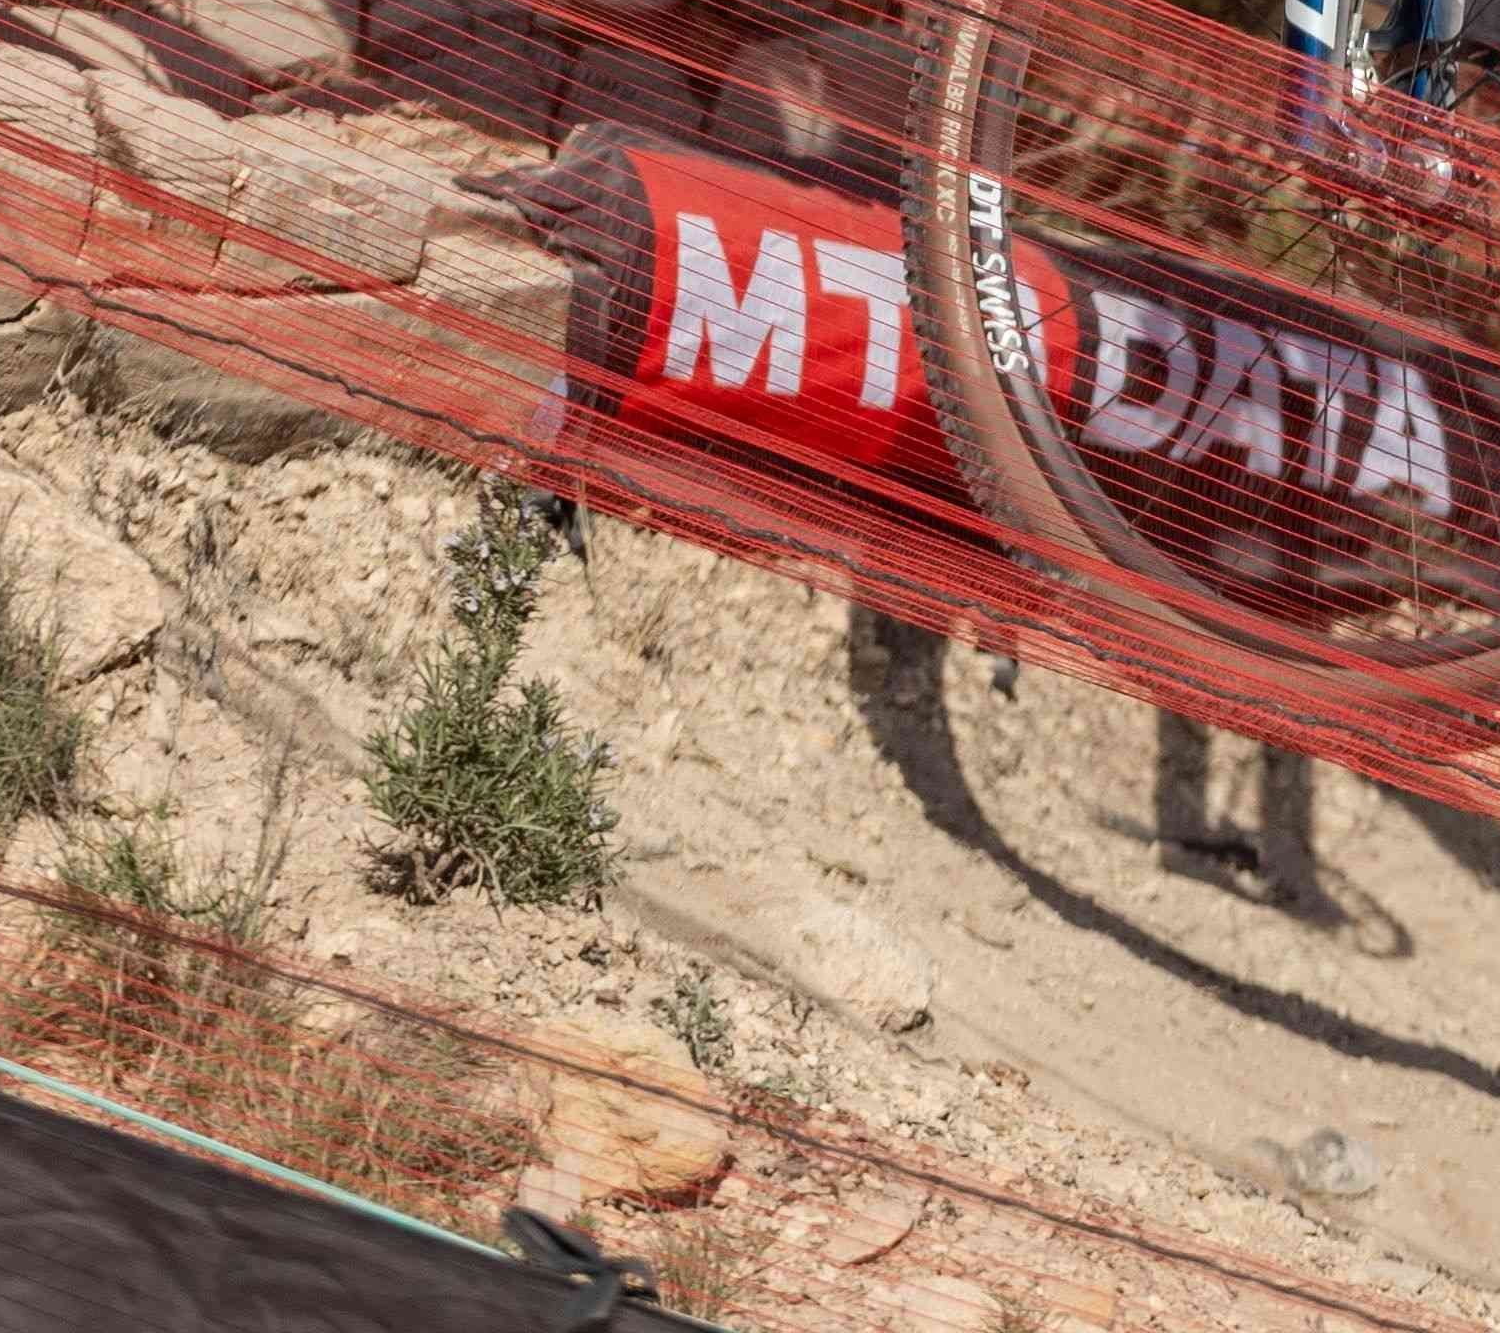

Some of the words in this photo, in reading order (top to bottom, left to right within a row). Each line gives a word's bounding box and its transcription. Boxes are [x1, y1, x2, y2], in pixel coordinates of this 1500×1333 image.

[968, 172, 1003, 241] DT
[973, 251, 1029, 374] SWISS
[1078, 288, 1453, 517] DATA
